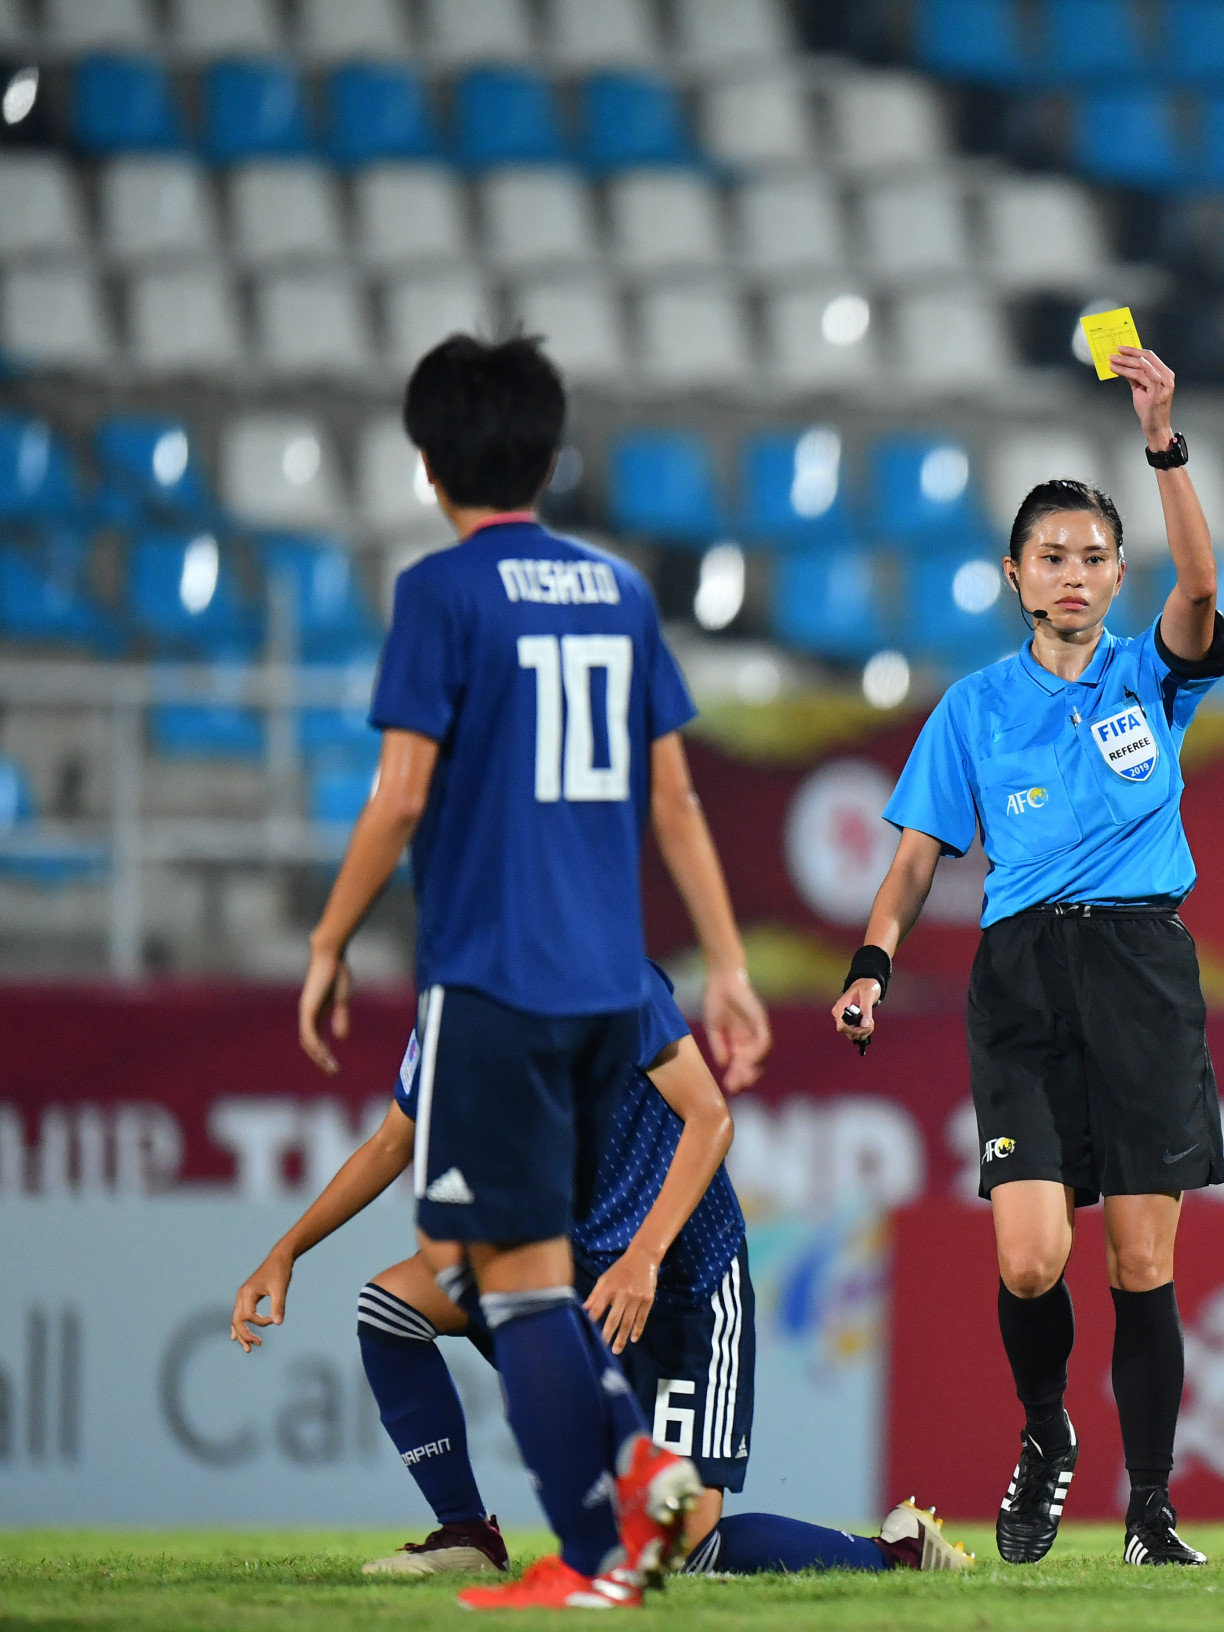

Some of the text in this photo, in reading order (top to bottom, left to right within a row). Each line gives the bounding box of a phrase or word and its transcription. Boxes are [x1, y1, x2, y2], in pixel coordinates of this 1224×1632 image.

[517, 634, 633, 802] 10
[1098, 713, 1141, 742] FIFA
[1108, 737, 1151, 761] REFEREE
[1129, 763, 1150, 777] 2019
[1007, 787, 1048, 816] AFC
[981, 1136, 1016, 1165] AFC
[653, 1378, 695, 1457] 6
